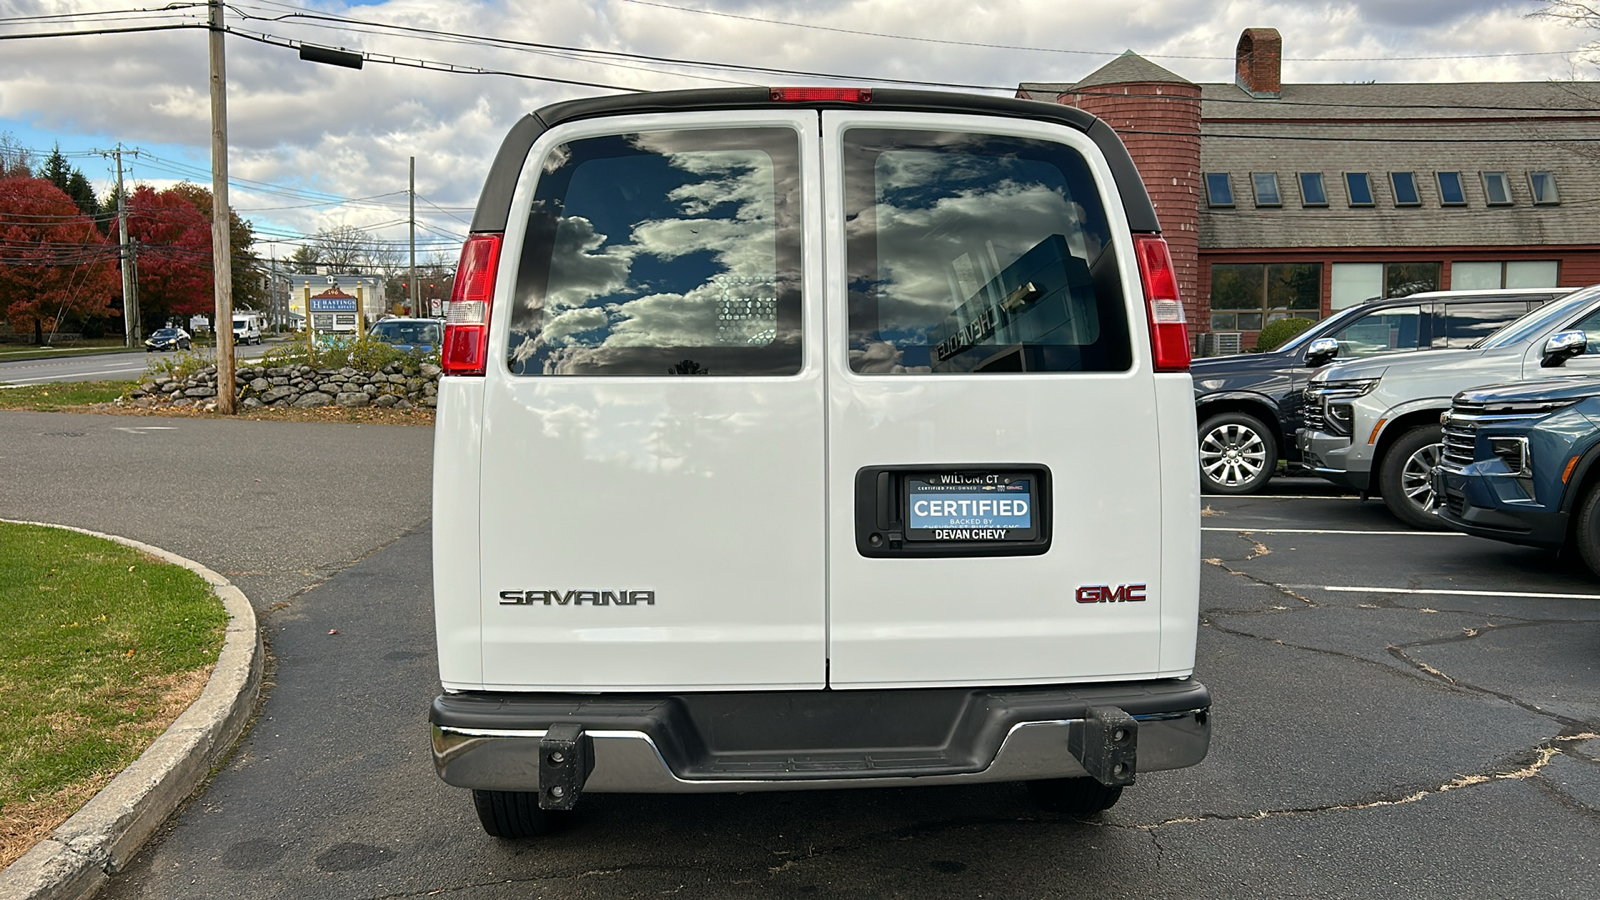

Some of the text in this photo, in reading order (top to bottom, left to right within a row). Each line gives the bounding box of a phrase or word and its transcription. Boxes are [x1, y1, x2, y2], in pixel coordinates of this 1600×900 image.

[313, 300, 321, 309] H
[986, 475, 999, 484] CT
[914, 500, 1028, 516] CERTIFIED
[935, 529, 1006, 539] DEVAN CHEVY
[499, 589, 655, 605] SAVANA
[1075, 582, 1146, 603] GMC
